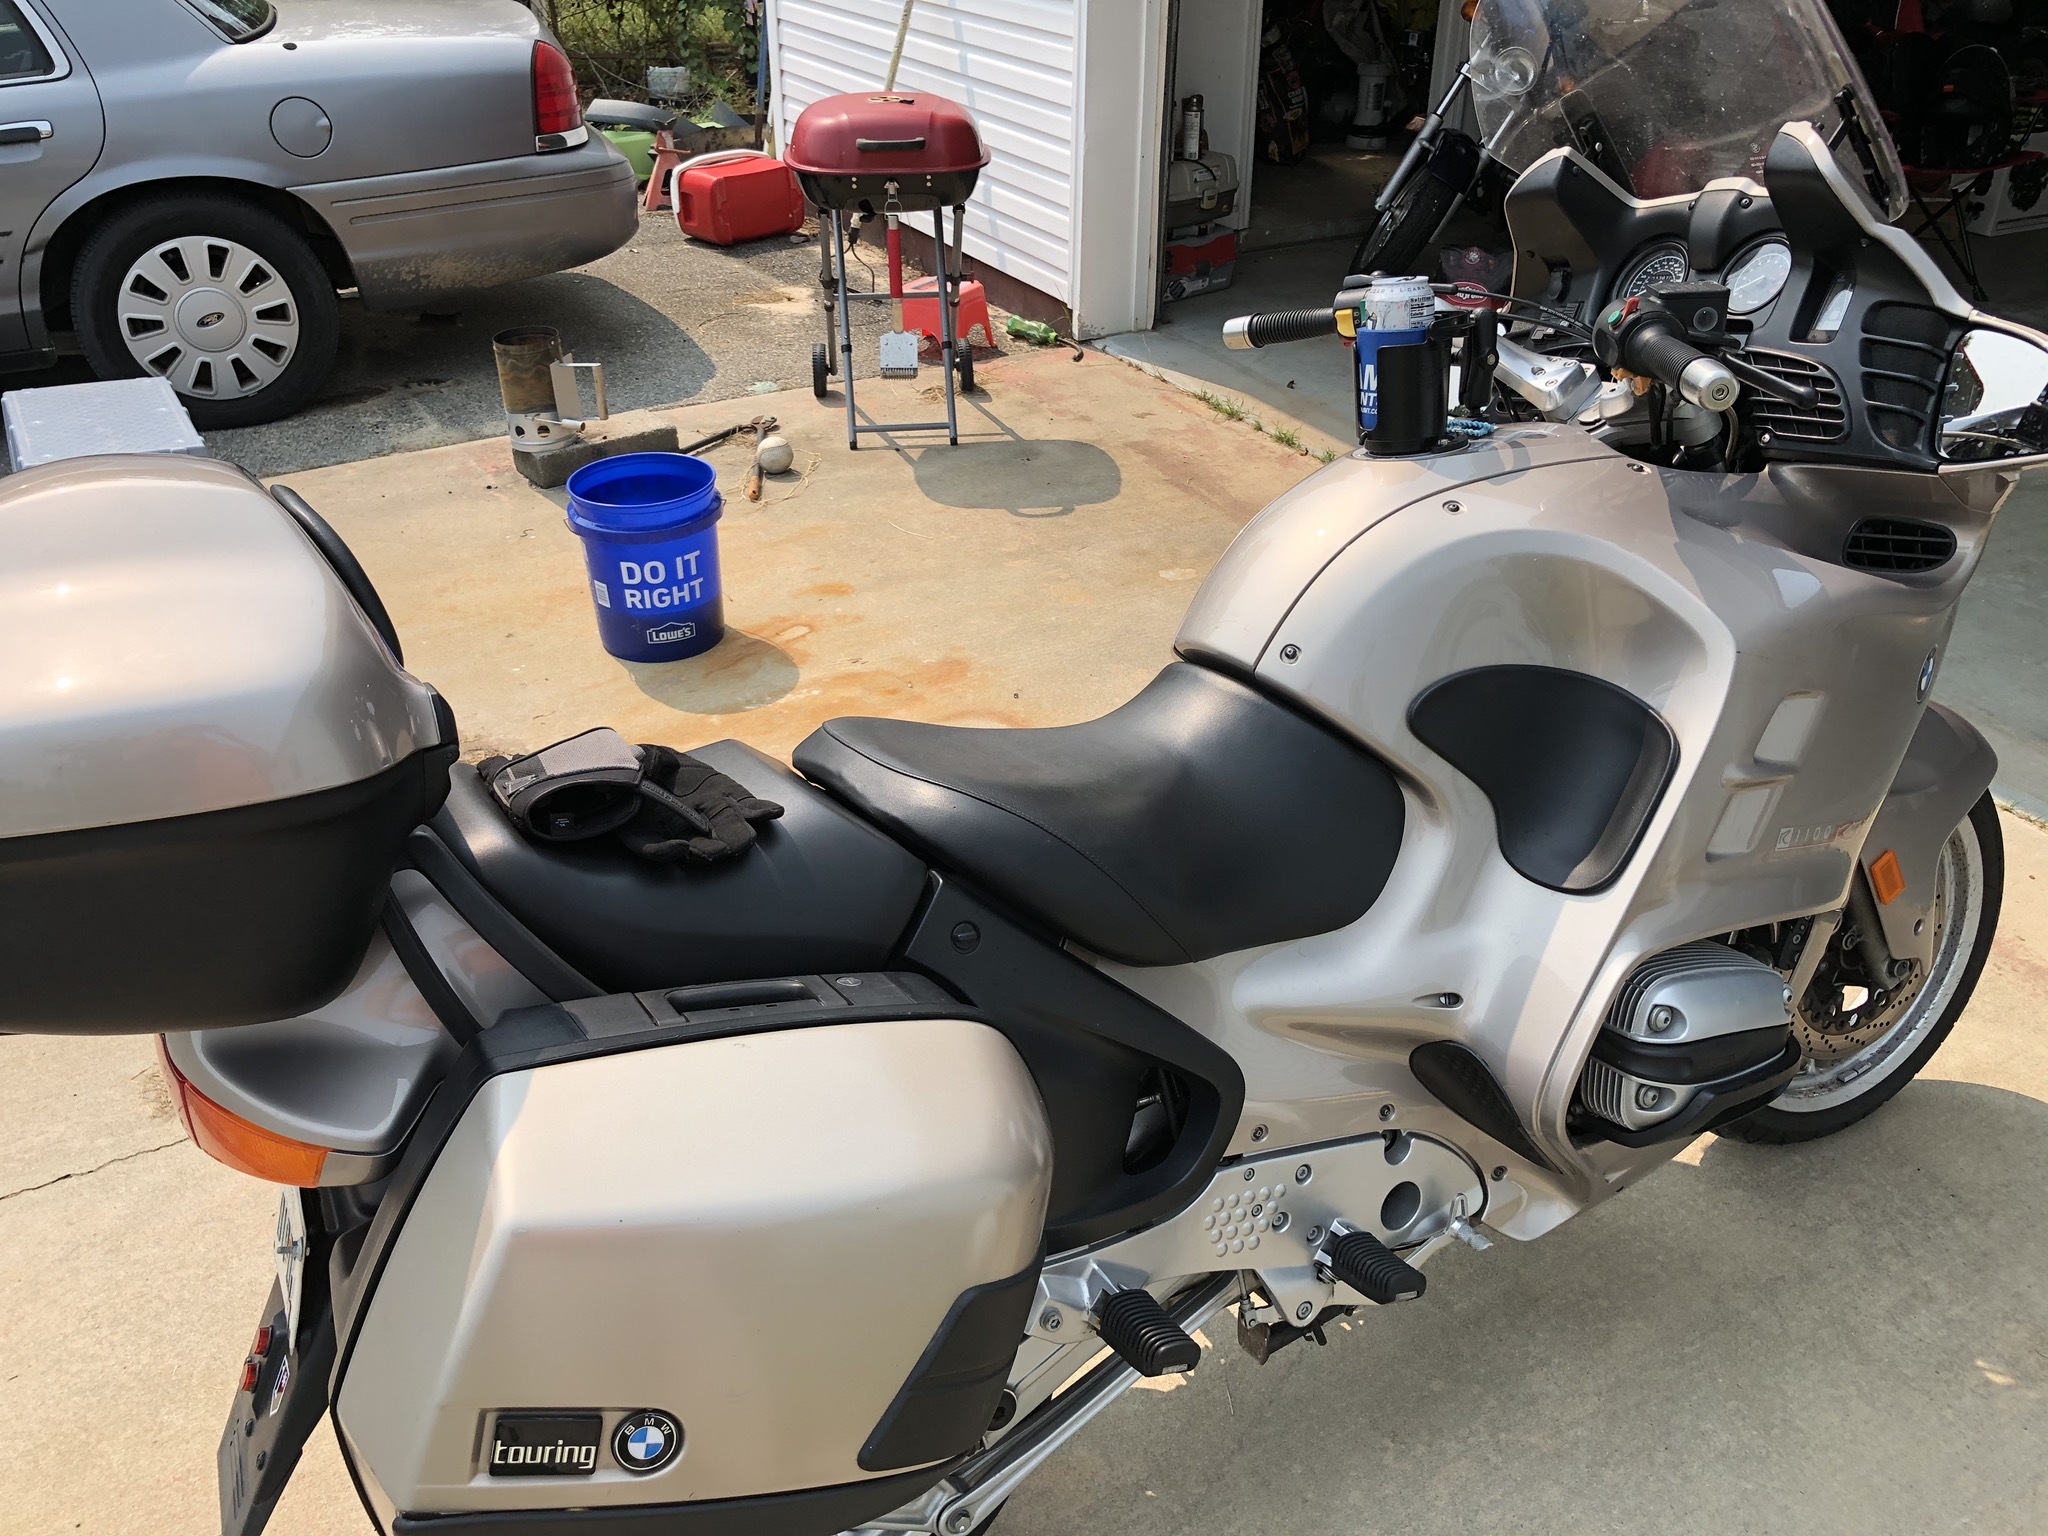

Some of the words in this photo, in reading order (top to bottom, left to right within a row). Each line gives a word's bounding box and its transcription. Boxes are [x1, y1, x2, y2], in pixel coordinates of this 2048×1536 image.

[1360, 392, 1378, 407] NT
[620, 561, 666, 585] DO
[676, 550, 701, 580] IT
[624, 577, 704, 609] RIGHT
[652, 627, 692, 642] LOWE'S
[493, 1439, 597, 1470] touring
